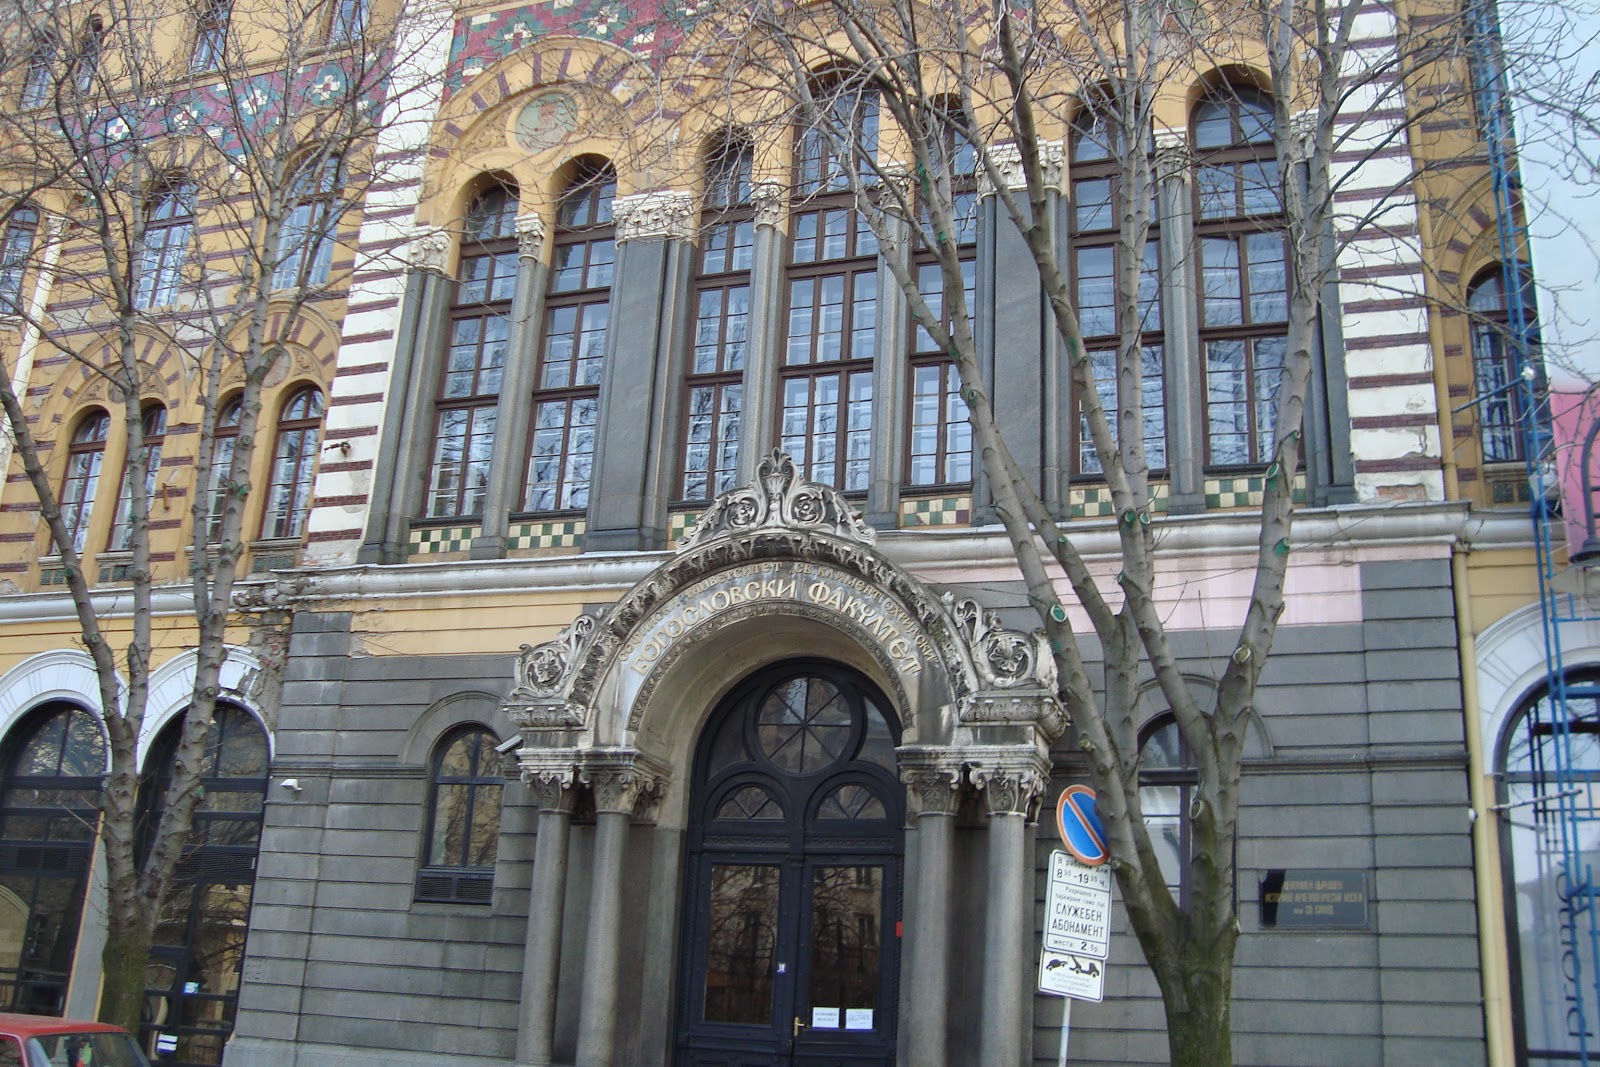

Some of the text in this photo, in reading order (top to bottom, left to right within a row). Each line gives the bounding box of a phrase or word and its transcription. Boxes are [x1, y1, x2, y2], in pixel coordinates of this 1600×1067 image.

[817, 565, 883, 600] КЛИМЕНТ
[631, 579, 923, 675] БОГОСЛОВСКИ ФАКУЛТЕТ
[1056, 903, 1102, 922] СЛУЖЕБЕН
[1052, 918, 1104, 938] АБОНАМЕНТ
[1081, 941, 1087, 951] 2
